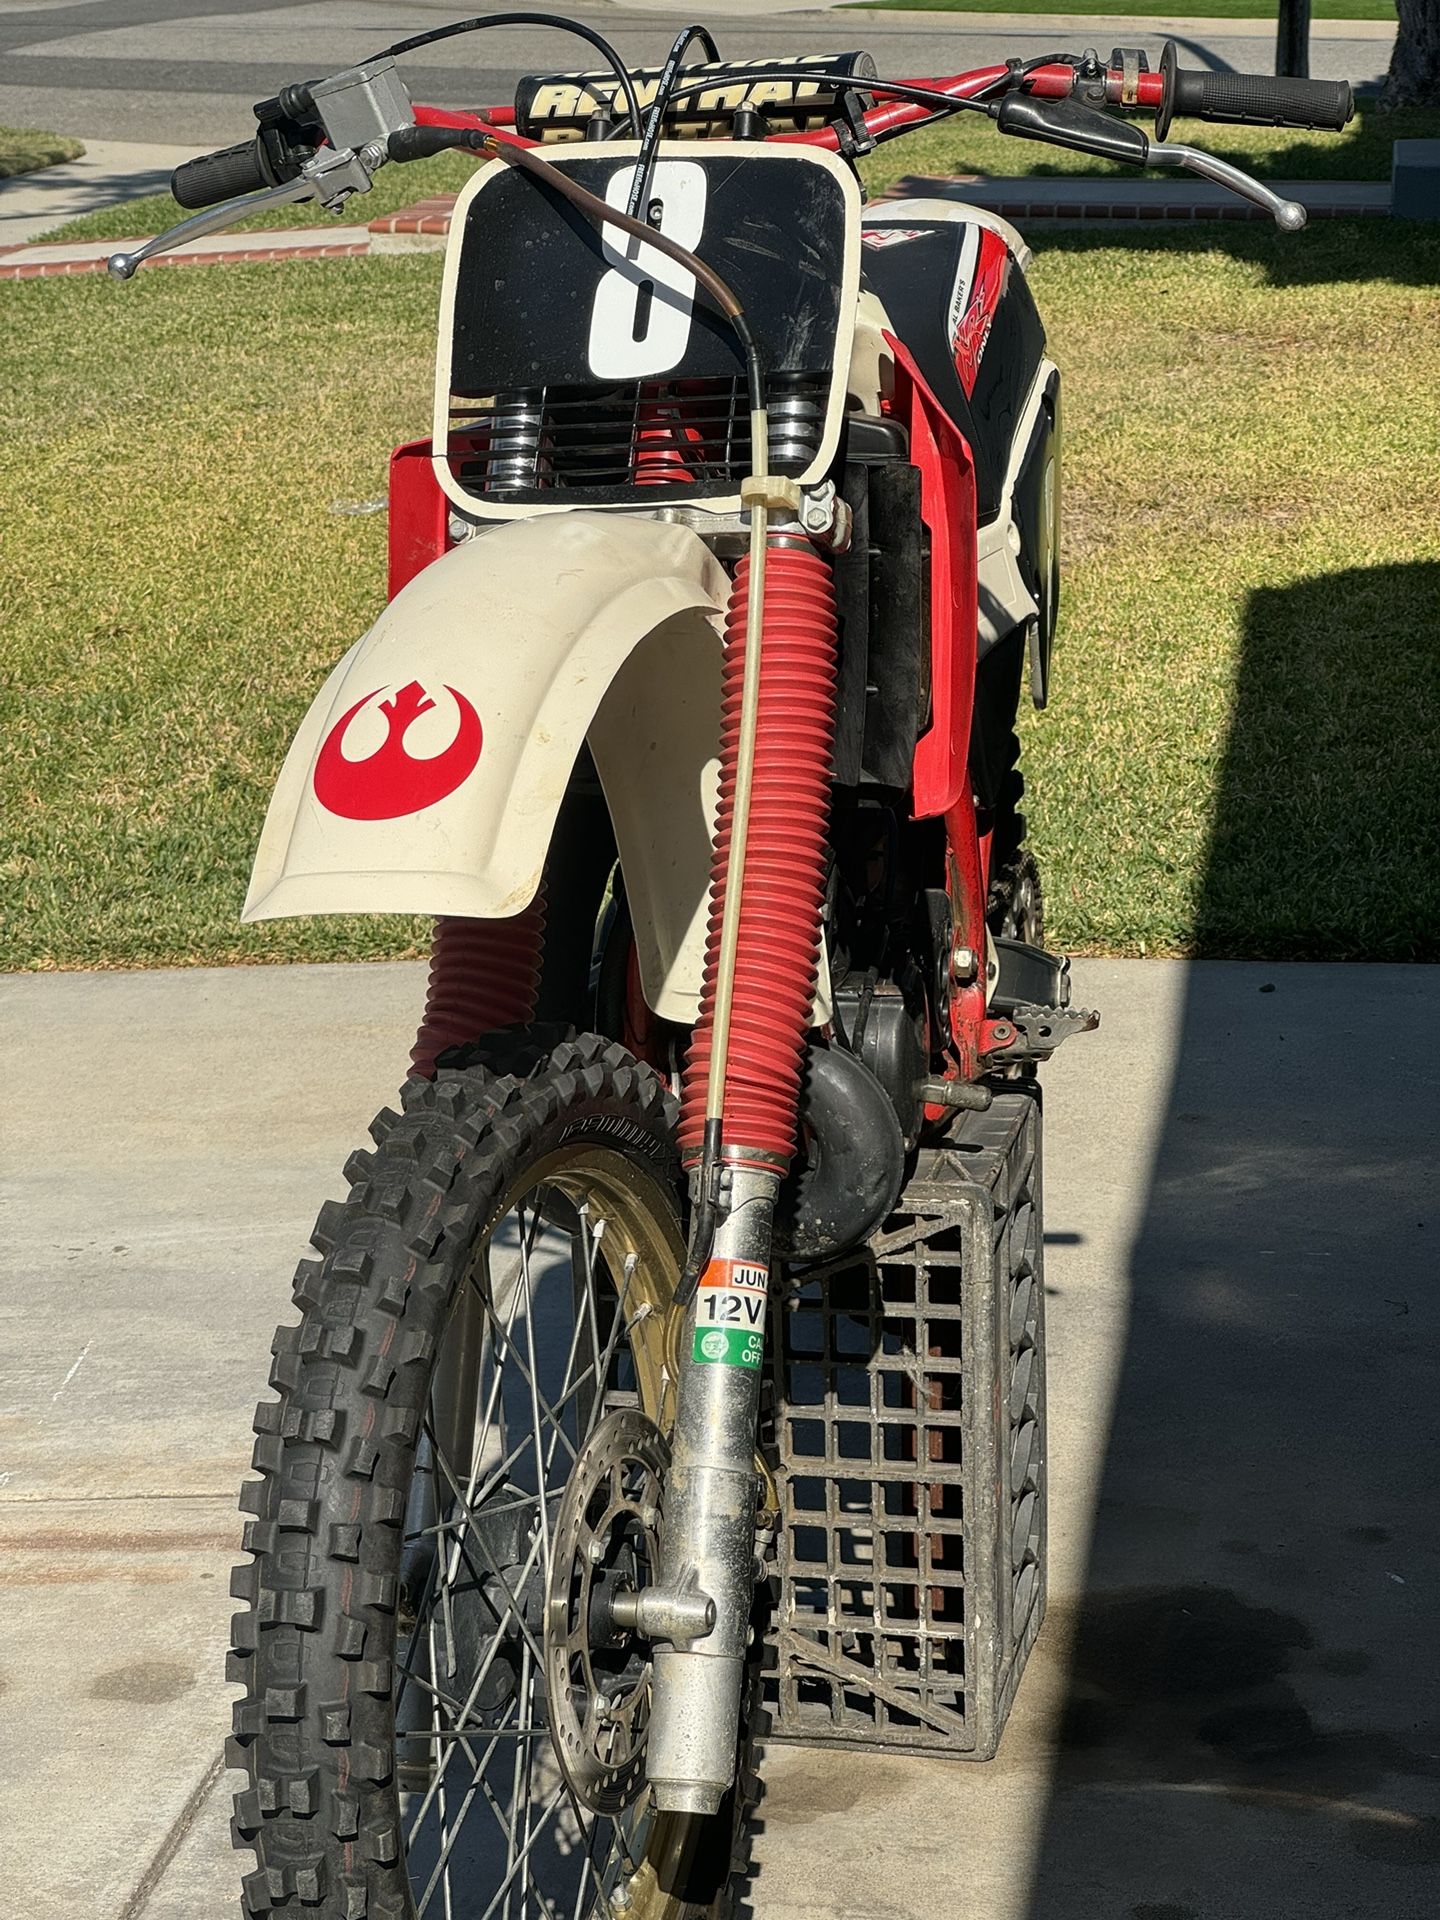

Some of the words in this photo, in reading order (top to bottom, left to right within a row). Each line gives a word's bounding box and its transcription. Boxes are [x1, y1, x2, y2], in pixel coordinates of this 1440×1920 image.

[588, 161, 708, 380] 8
[954, 279, 966, 314] BAKER'S
[734, 1269, 767, 1289] JUN
[703, 1294, 763, 1325] 12V
